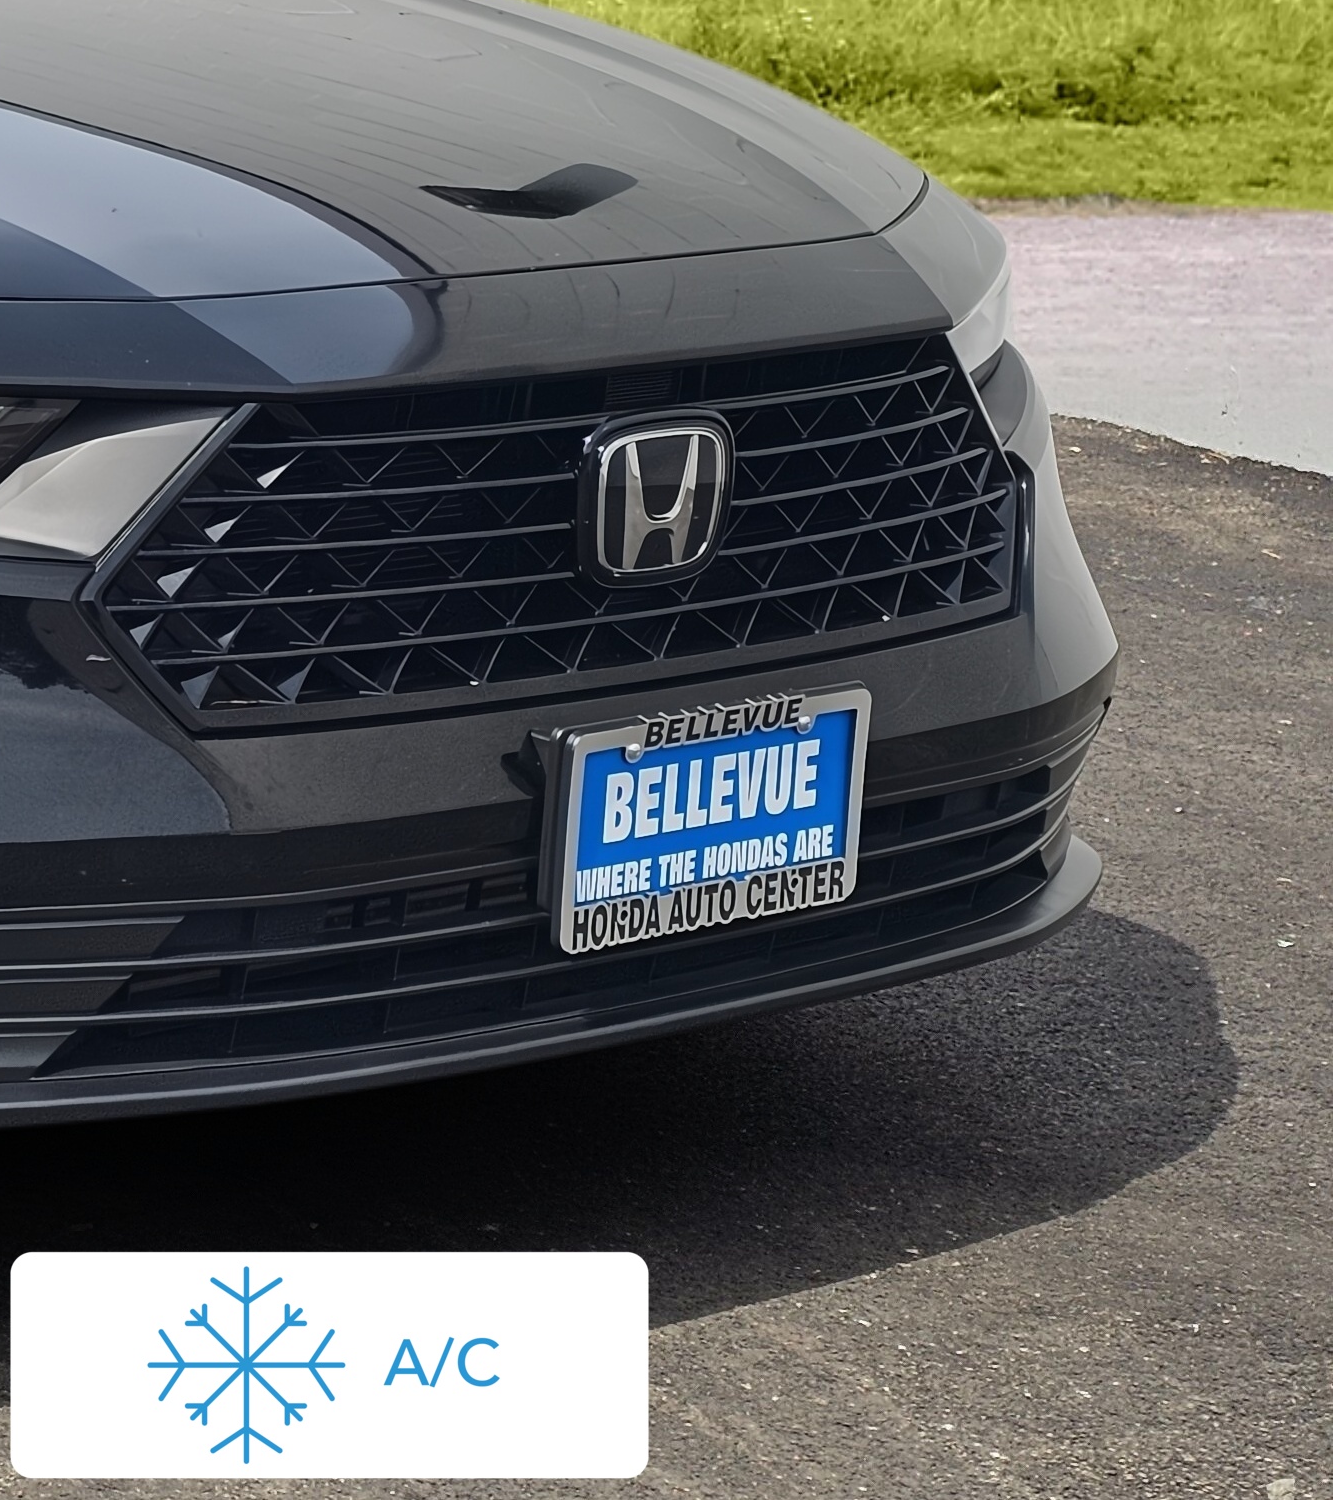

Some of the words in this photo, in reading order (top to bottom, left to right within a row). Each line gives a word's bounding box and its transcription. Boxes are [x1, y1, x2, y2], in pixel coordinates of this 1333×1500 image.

[644, 697, 804, 748] BELLEVUE
[602, 738, 821, 844] BELLEVUE
[576, 858, 652, 902] WHERE
[659, 849, 696, 887] THE
[702, 832, 788, 878] HONDAS
[793, 824, 834, 862] ARE
[572, 898, 660, 950] HONDA
[668, 879, 736, 931] AUTO
[746, 861, 845, 917] CENTER
